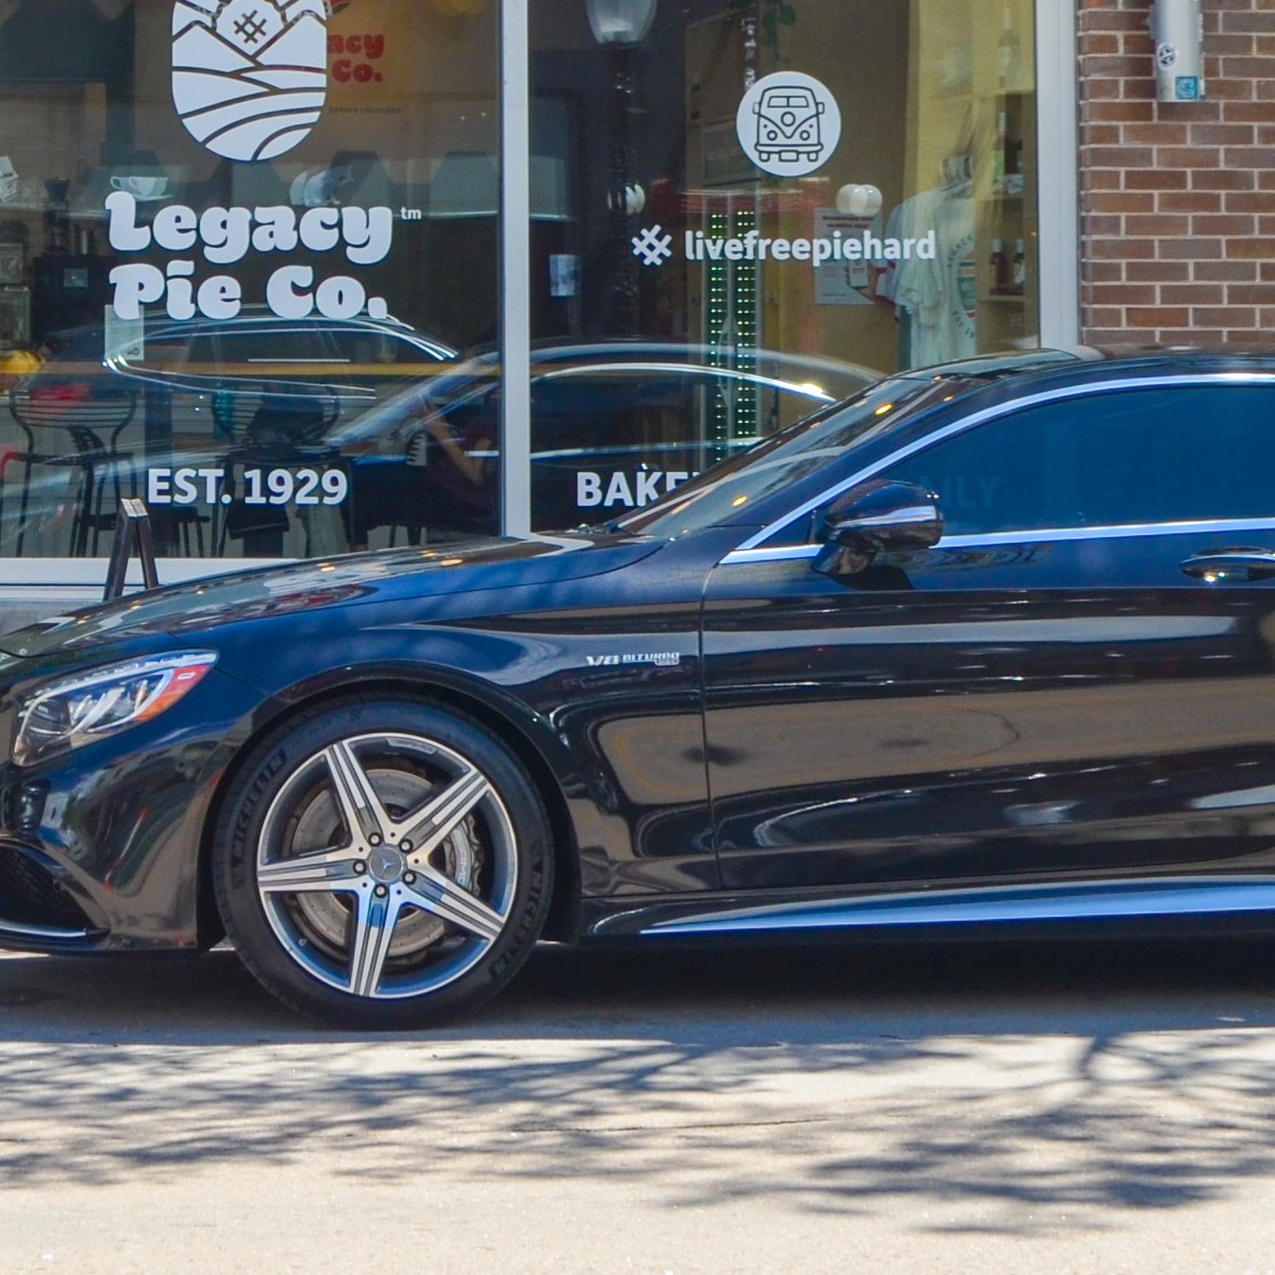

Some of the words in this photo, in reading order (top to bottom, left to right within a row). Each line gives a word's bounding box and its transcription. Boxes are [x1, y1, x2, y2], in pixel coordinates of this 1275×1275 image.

[327, 34, 385, 60] acy
[105, 190, 394, 265] Legacy
[684, 229, 936, 267] livefreepiehard
[109, 260, 241, 321] Pie
[265, 265, 389, 322] Co.
[148, 468, 232, 505] EST.
[244, 469, 347, 505] 1929
[577, 471, 700, 507] BAK
